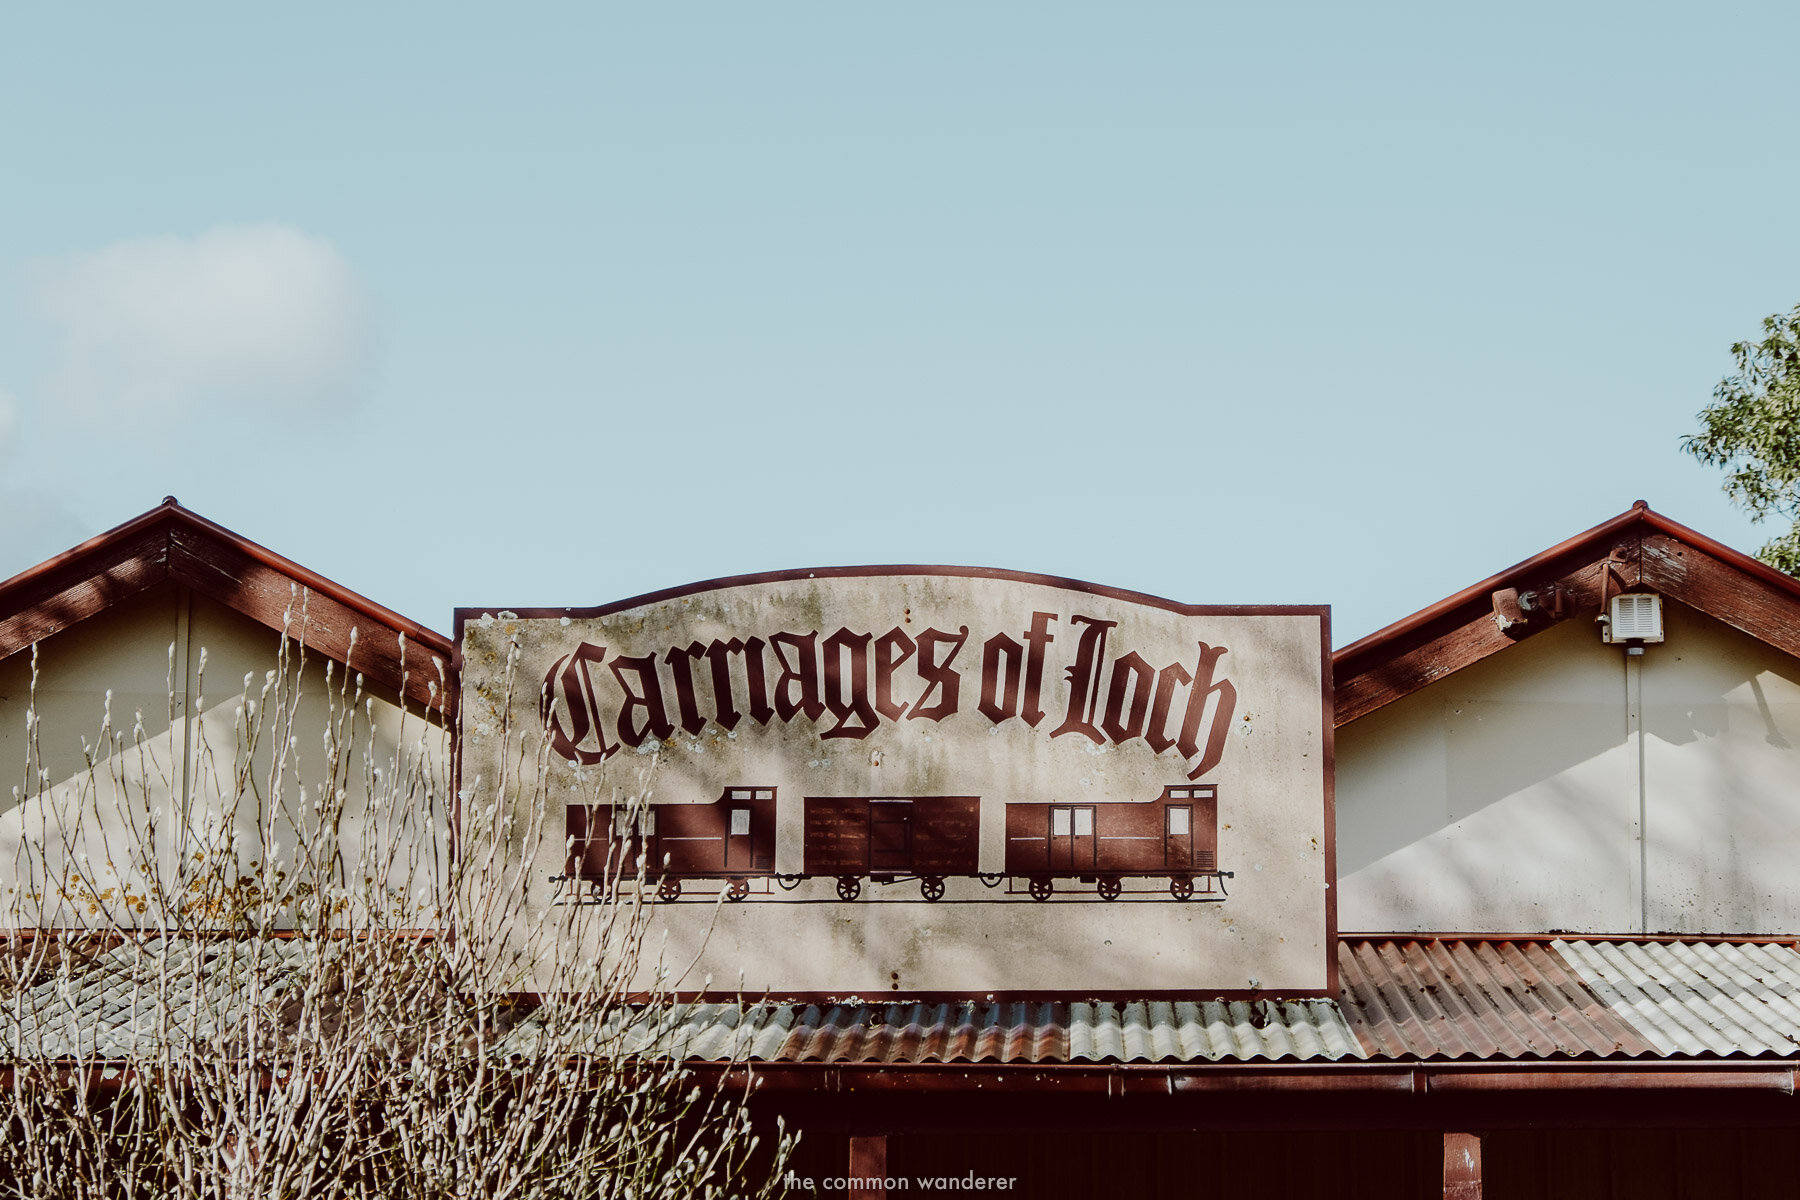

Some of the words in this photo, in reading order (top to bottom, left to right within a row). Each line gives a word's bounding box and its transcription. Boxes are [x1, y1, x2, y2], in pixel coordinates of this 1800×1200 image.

[540, 626, 969, 765] Carriages
[977, 611, 1059, 728] of
[1049, 614, 1237, 781] Loch
